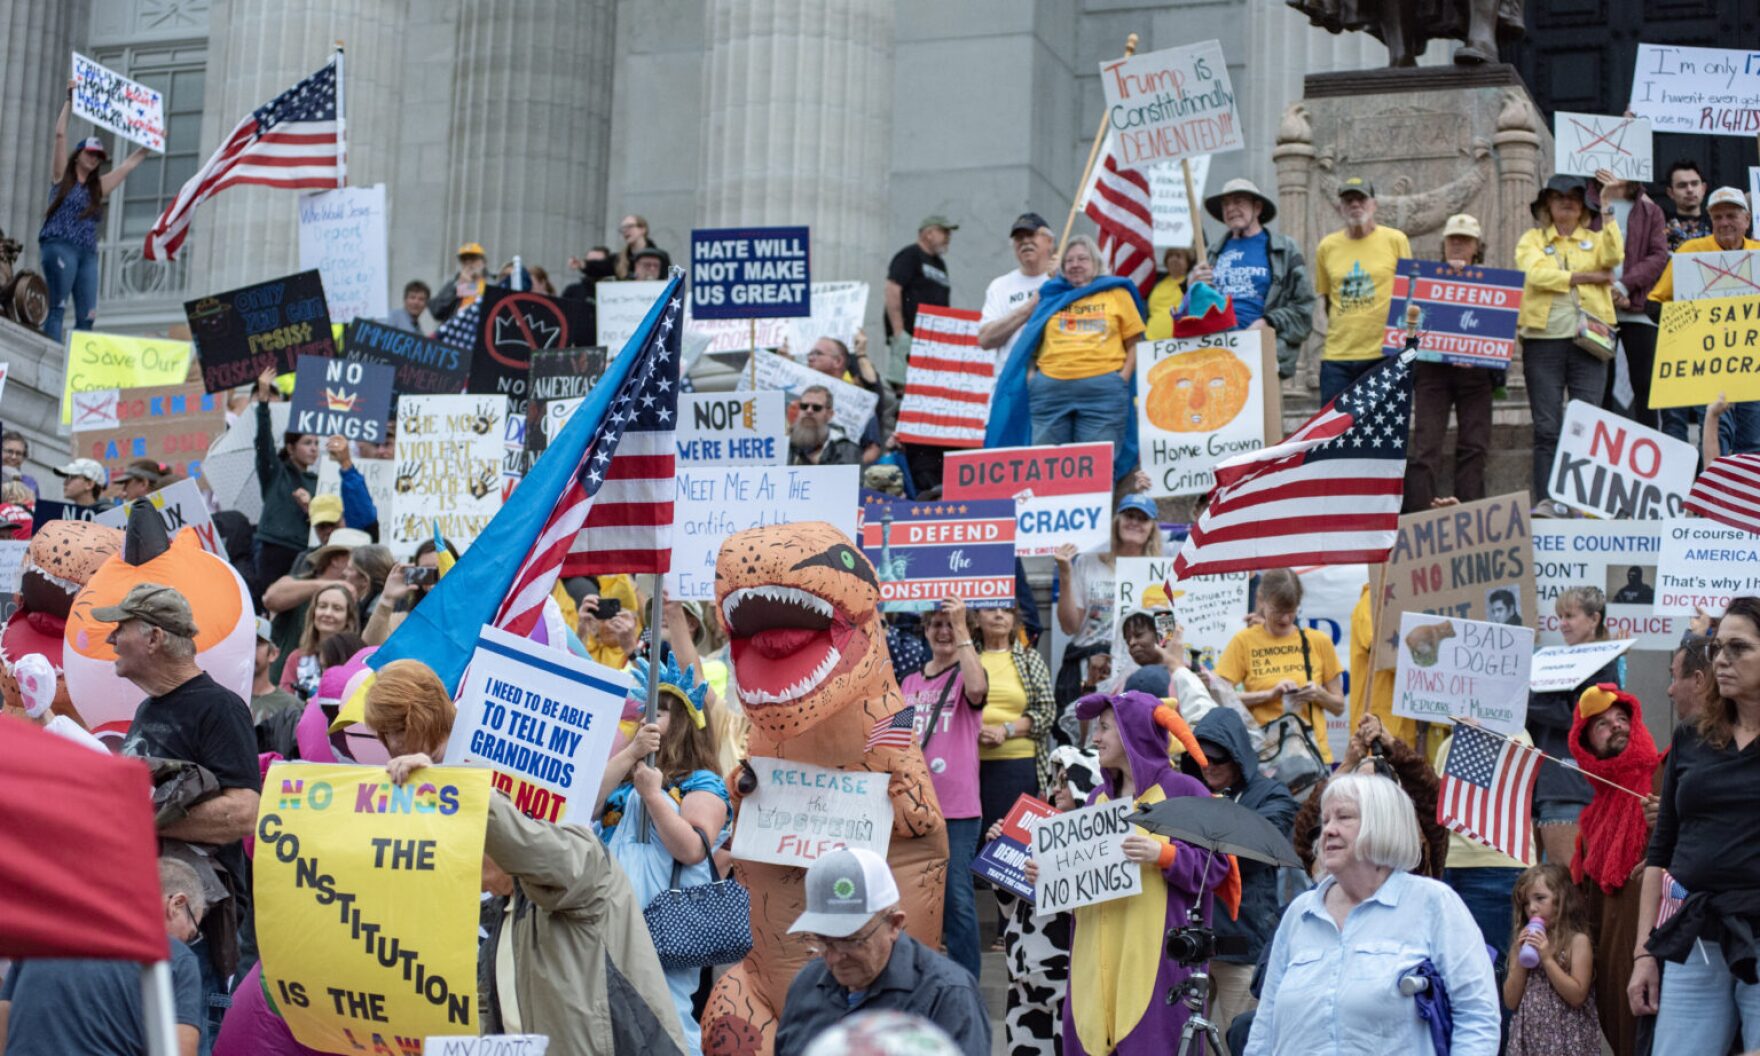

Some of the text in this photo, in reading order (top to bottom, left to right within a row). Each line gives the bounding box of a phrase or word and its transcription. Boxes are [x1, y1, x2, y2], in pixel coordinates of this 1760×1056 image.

[1104, 61, 1185, 99] Trump
[1649, 48, 1696, 75] I'm
[1704, 56, 1738, 89] only
[1637, 81, 1656, 102] I
[1568, 151, 1600, 174] NO
[694, 238, 805, 260] HATE WILL
[694, 260, 806, 282] NOT MAKE
[694, 284, 726, 306] US
[730, 283, 806, 305] GREAT
[1008, 291, 1024, 304] NO
[1430, 283, 1507, 305] DEFEND
[355, 321, 462, 370] IMMIGRANTS
[1153, 340, 1190, 360] For
[1387, 330, 1510, 357] COSTITUTION
[1703, 329, 1758, 352] OUR
[81, 341, 181, 372] Save Our
[326, 360, 363, 385] NO
[497, 375, 526, 395] NO
[298, 409, 380, 441] KINGS
[676, 436, 776, 461] WE'RE HERE
[1153, 434, 1262, 465] Home Grown
[1589, 419, 1662, 479] NO
[958, 455, 1094, 487] DICTATOR
[676, 472, 716, 501] MEET
[724, 472, 751, 501] ME
[788, 471, 811, 500] THE
[684, 511, 737, 536] antifa
[909, 523, 999, 544] DEFEND
[1018, 506, 1102, 534] CRACY
[1392, 500, 1526, 565] AMERICA
[1672, 527, 1744, 540] Of course
[1410, 546, 1524, 596] NO KINGS
[1535, 563, 1589, 578] DON'T
[1661, 575, 1706, 588] That's
[1711, 577, 1742, 592] why
[880, 580, 1010, 599] ONSTITUTION
[1463, 622, 1515, 650] BAD
[1606, 616, 1673, 634] POLICE
[1251, 645, 1311, 658] DEMOCRA
[1453, 647, 1519, 676] DOGE!
[1406, 668, 1482, 697] PAWS OFF
[485, 677, 594, 731] I NEED TO BE ABLE
[482, 699, 583, 758] TO TELL MY
[470, 729, 575, 789] GRANDKIDS
[279, 779, 334, 811] NO
[771, 769, 869, 795] RELEASE
[514, 781, 567, 824] NOT
[807, 796, 828, 812] the
[757, 804, 873, 841] EPSTEIN
[1037, 805, 1130, 854] DRAGONS
[371, 837, 437, 870] THE
[776, 834, 846, 860] FILE
[1056, 840, 1109, 872] HAVE
[1042, 860, 1133, 909] NO KINGS
[258, 813, 470, 1026] CONSTITUTION
[277, 979, 389, 1023] IS THE
